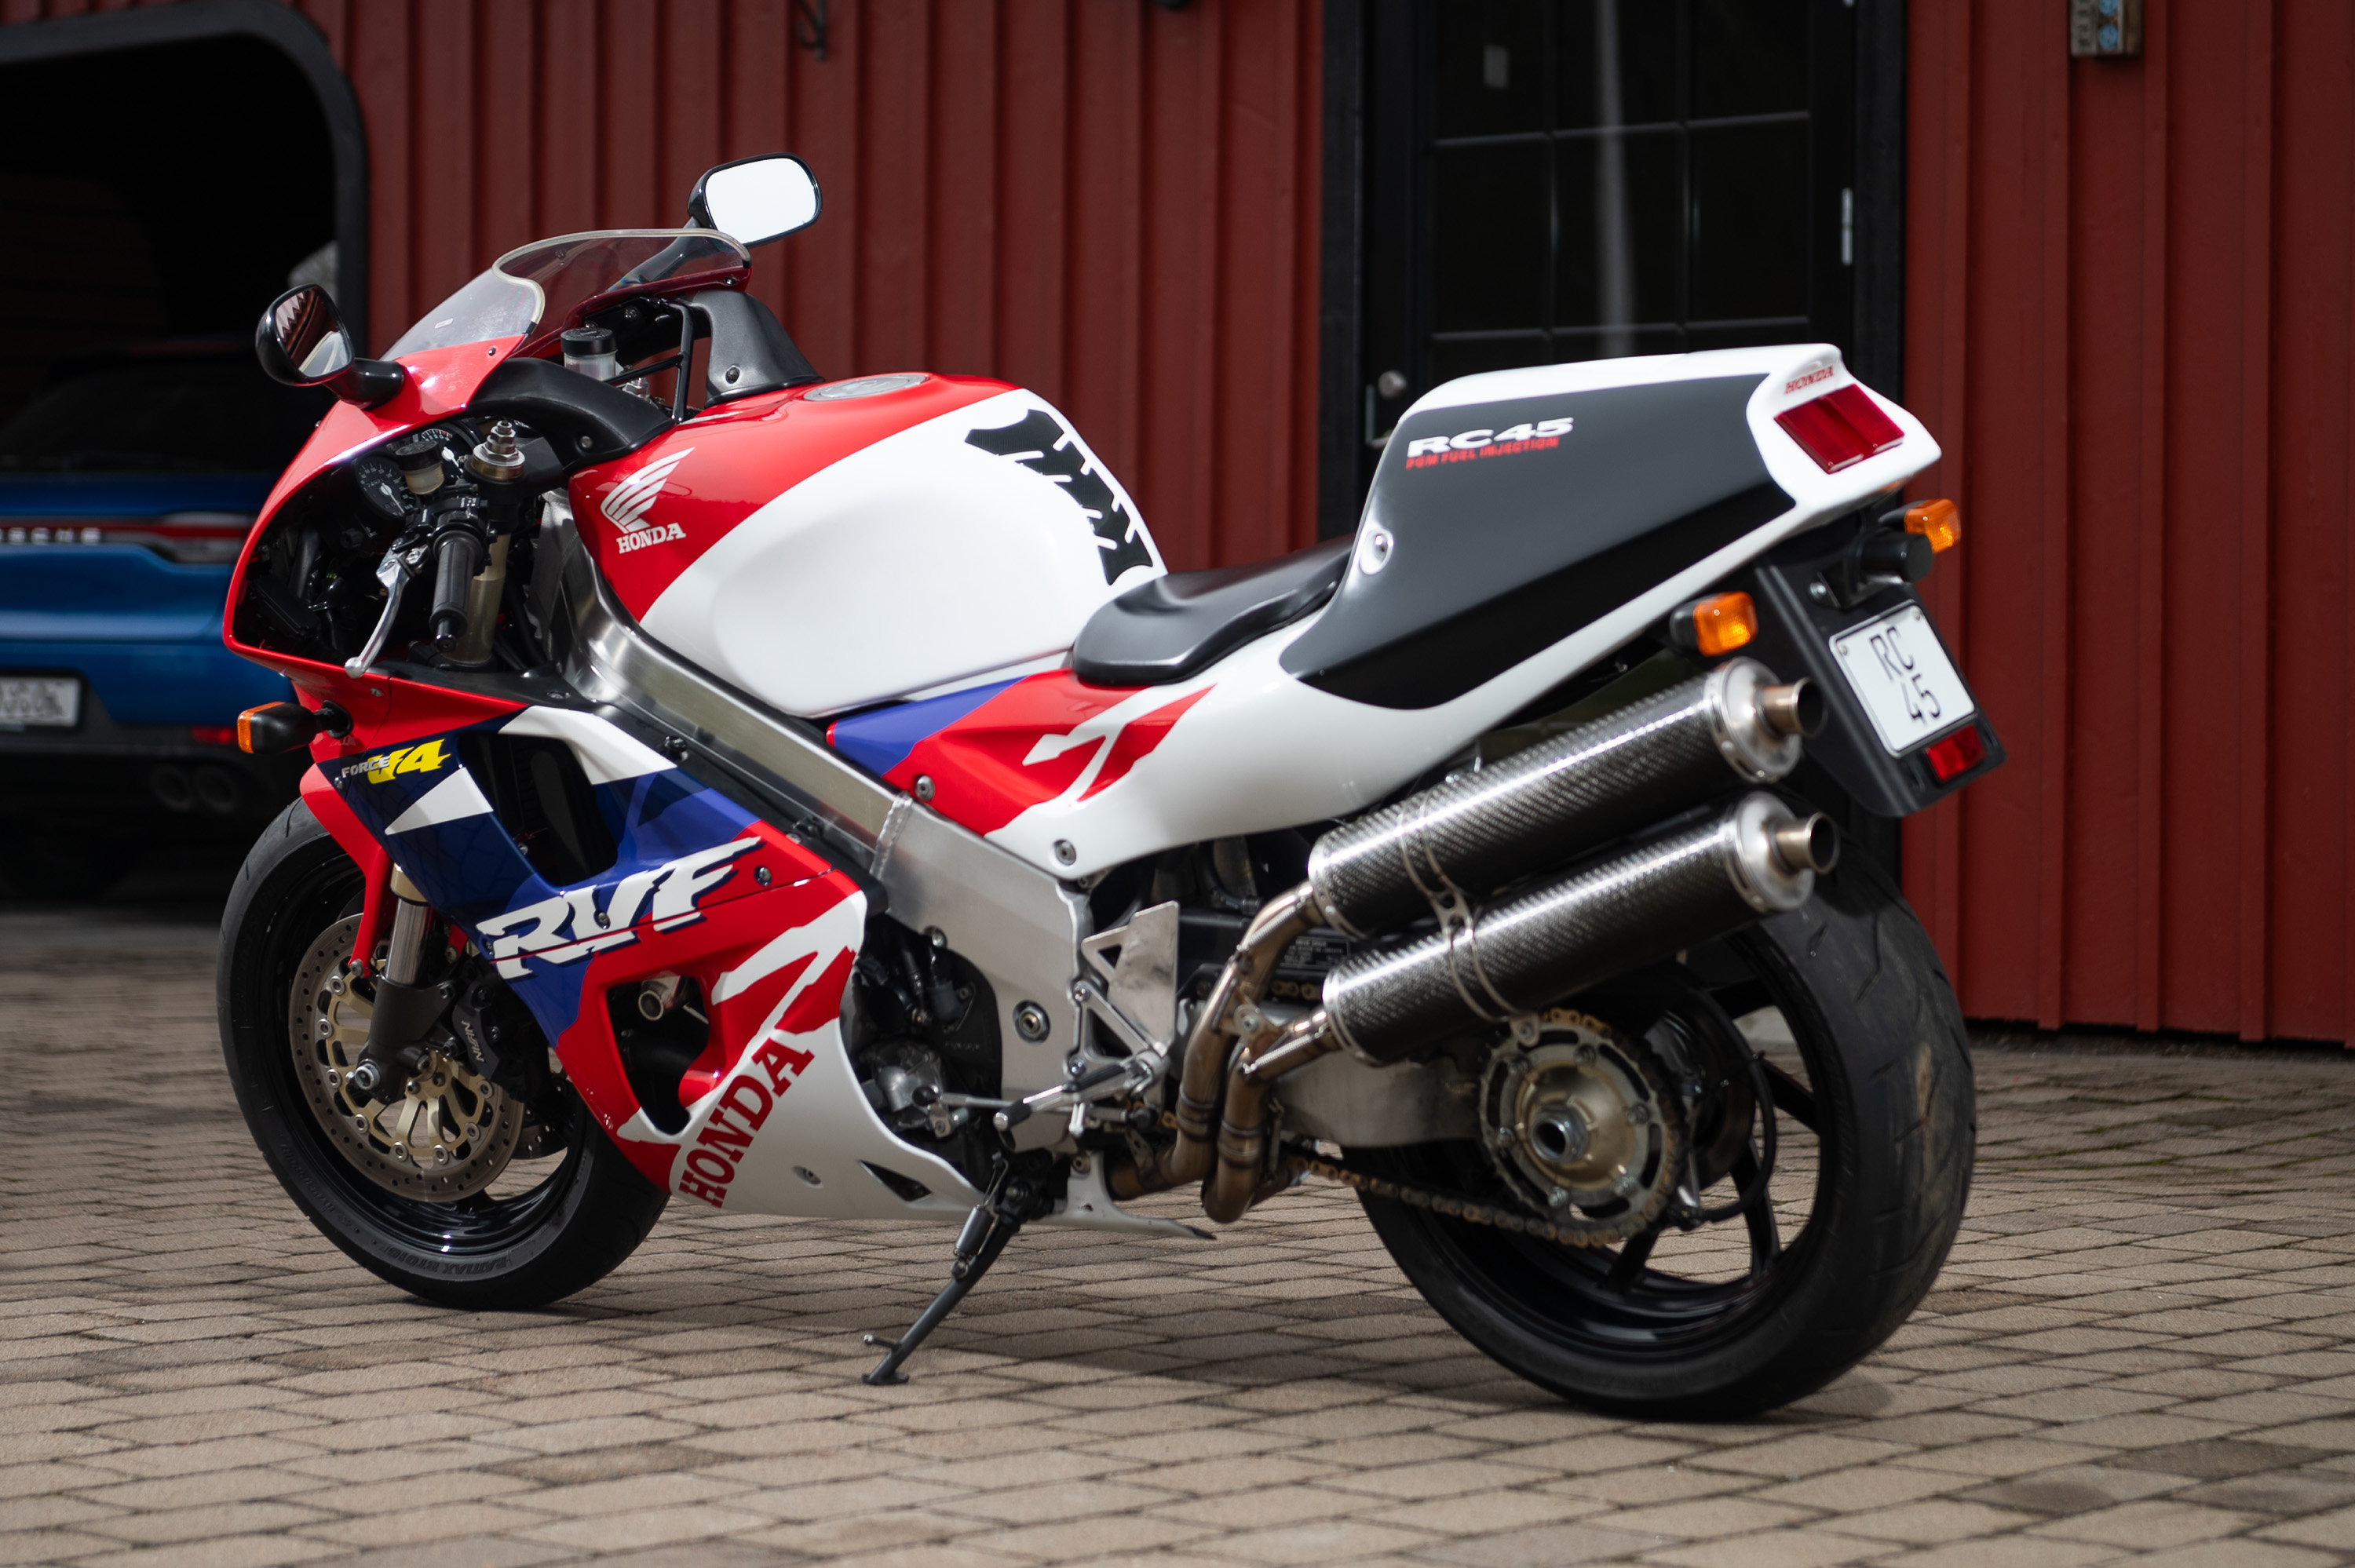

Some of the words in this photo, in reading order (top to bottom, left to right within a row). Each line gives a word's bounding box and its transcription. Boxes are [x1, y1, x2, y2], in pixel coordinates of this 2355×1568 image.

[1784, 366, 1834, 394] HONDA
[1405, 454, 1439, 470] PGM
[1440, 450, 1477, 464] FUEL
[1479, 436, 1561, 458] INJECTION
[1407, 417, 1574, 458] RC45
[0, 527, 101, 545] SCHE
[616, 522, 686, 554] HONDA
[1869, 626, 1915, 683] RC
[1901, 673, 1941, 725] 45
[341, 756, 390, 779] FORCE
[367, 738, 451, 785] V4
[475, 835, 766, 980] RVF
[678, 1036, 816, 1209] HONDA
